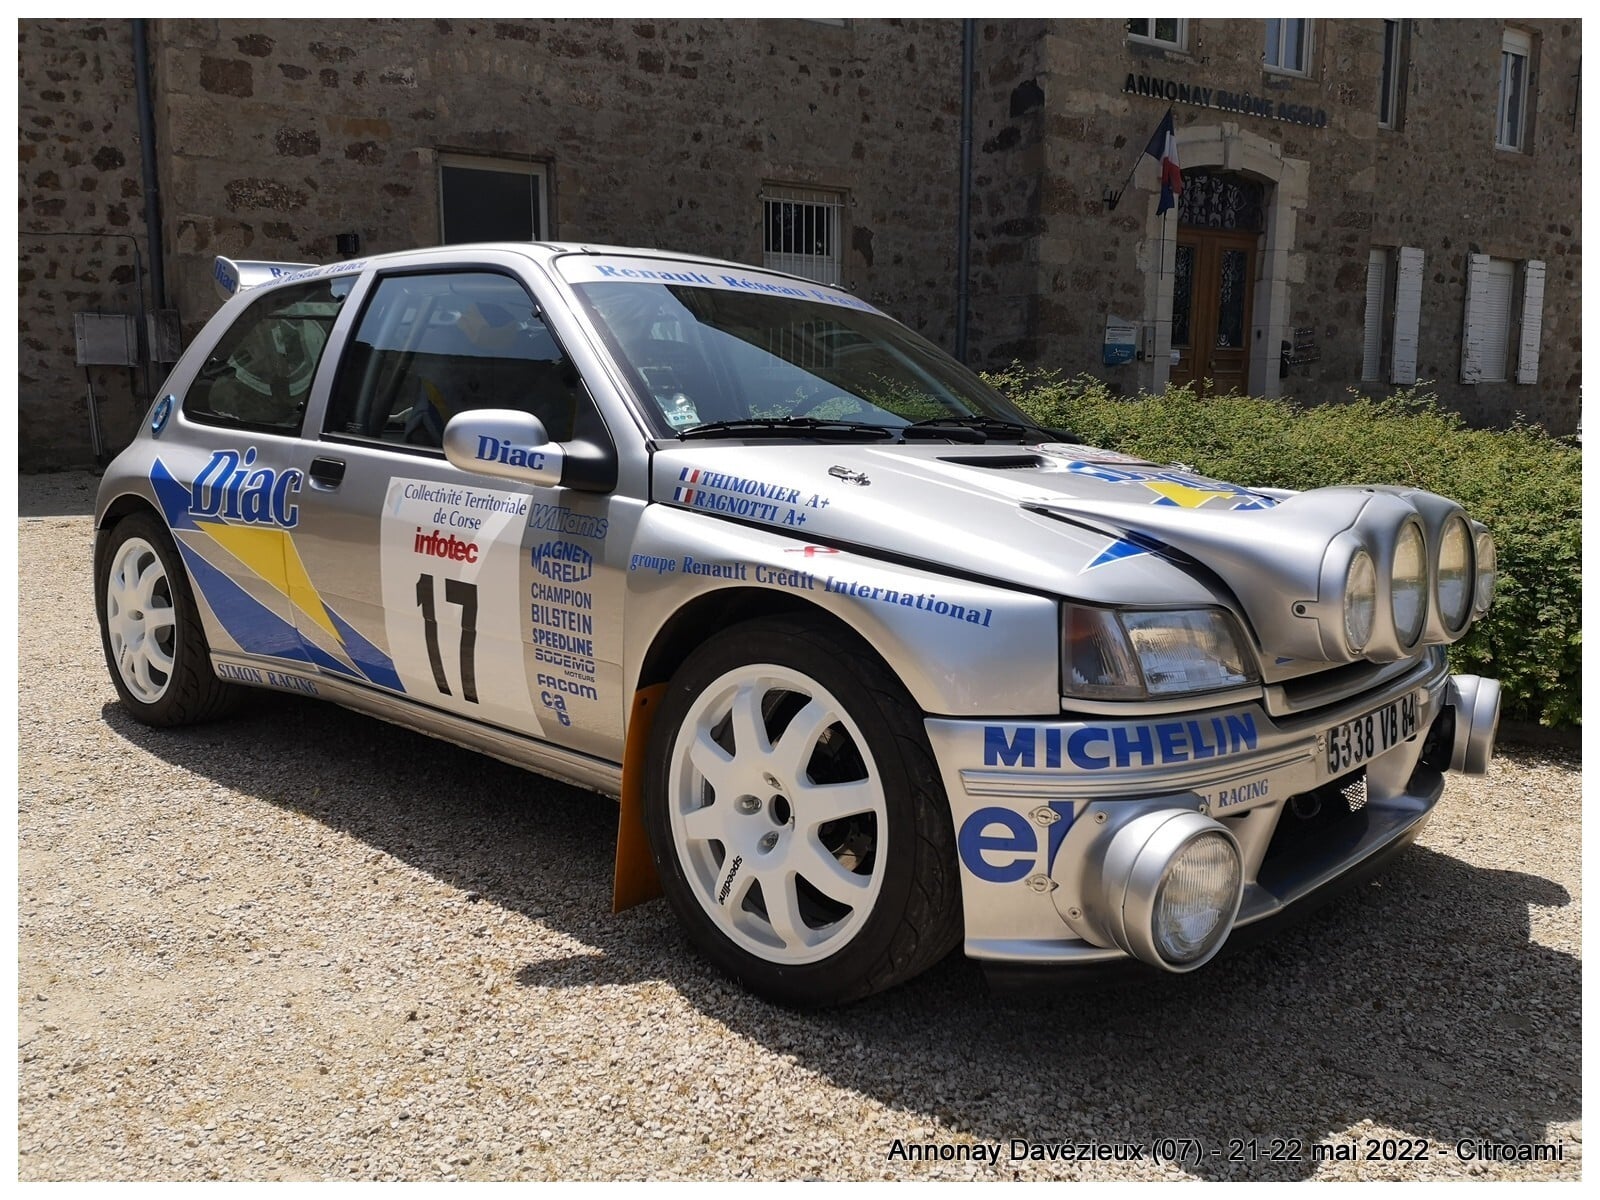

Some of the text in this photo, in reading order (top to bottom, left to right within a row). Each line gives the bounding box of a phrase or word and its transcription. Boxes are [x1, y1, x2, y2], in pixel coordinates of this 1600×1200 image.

[1123, 73, 1214, 107] ANNONAY
[595, 263, 716, 286] Renault
[720, 274, 809, 299] Réseau
[475, 434, 545, 470] Diac
[188, 446, 304, 528] Diac
[404, 483, 527, 516] Collectivité Territoriale
[701, 470, 830, 509] THIMONIER A+
[433, 508, 482, 530] de Corse
[694, 490, 807, 526] RAGNOTTI A+
[414, 527, 479, 563] infotec
[531, 540, 593, 566] MAGNETI
[531, 557, 593, 583] MARELLI
[531, 582, 592, 610] CHAMPION
[630, 552, 993, 628] groupe Renault Crédit International
[531, 603, 593, 635] BILSTEIN
[416, 573, 480, 705] 17
[532, 628, 593, 657] SPEEDLINE
[217, 663, 320, 695] SIMON RACING
[564, 670, 595, 683] MOTEURS
[983, 712, 1259, 770] MICHELIN
[1329, 693, 1417, 775] 5338 VB 84
[1218, 779, 1269, 809] RACING
[718, 855, 743, 906] speedline
